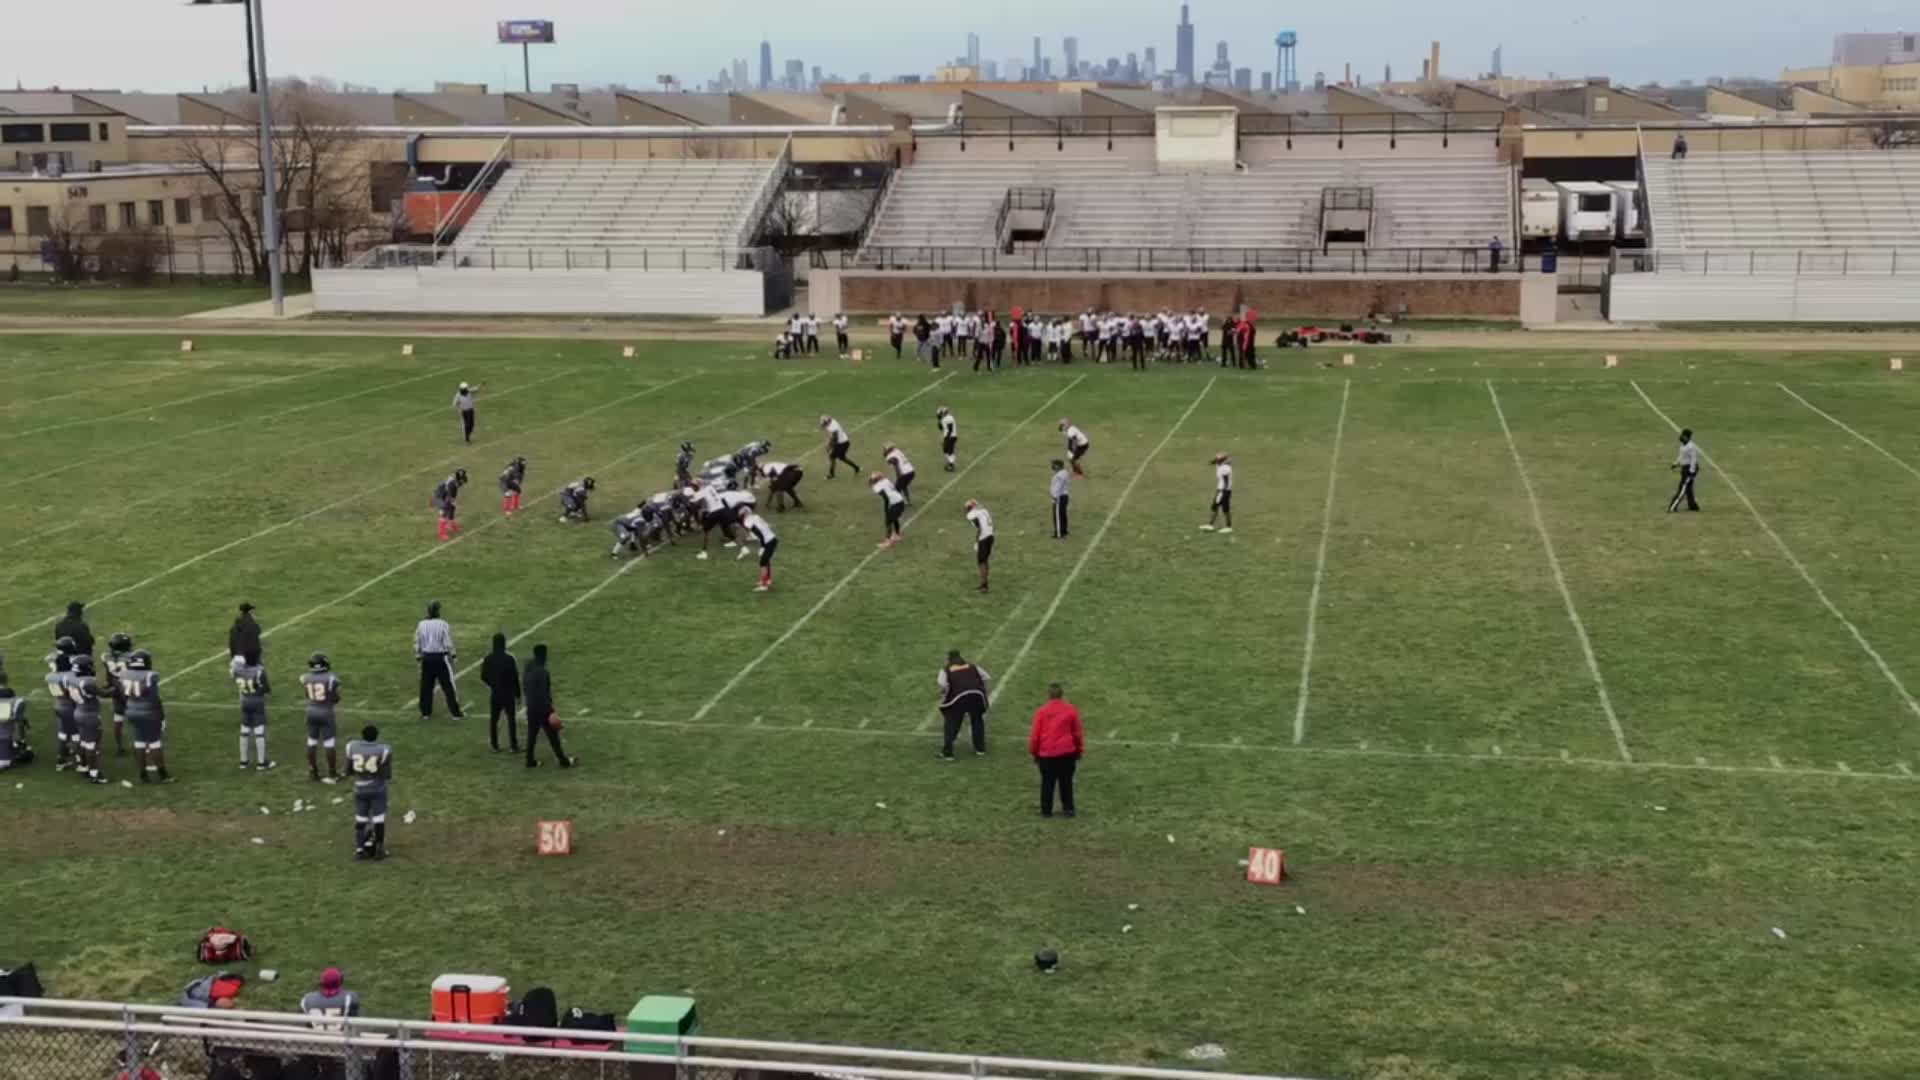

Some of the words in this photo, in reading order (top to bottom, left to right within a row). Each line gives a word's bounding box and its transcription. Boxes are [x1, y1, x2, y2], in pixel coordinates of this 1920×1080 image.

[122, 679, 141, 697] 71
[236, 678, 256, 693] 21
[304, 683, 326, 701] 12
[352, 754, 378, 773] 24
[541, 822, 569, 853] 50
[1250, 849, 1280, 880] 40
